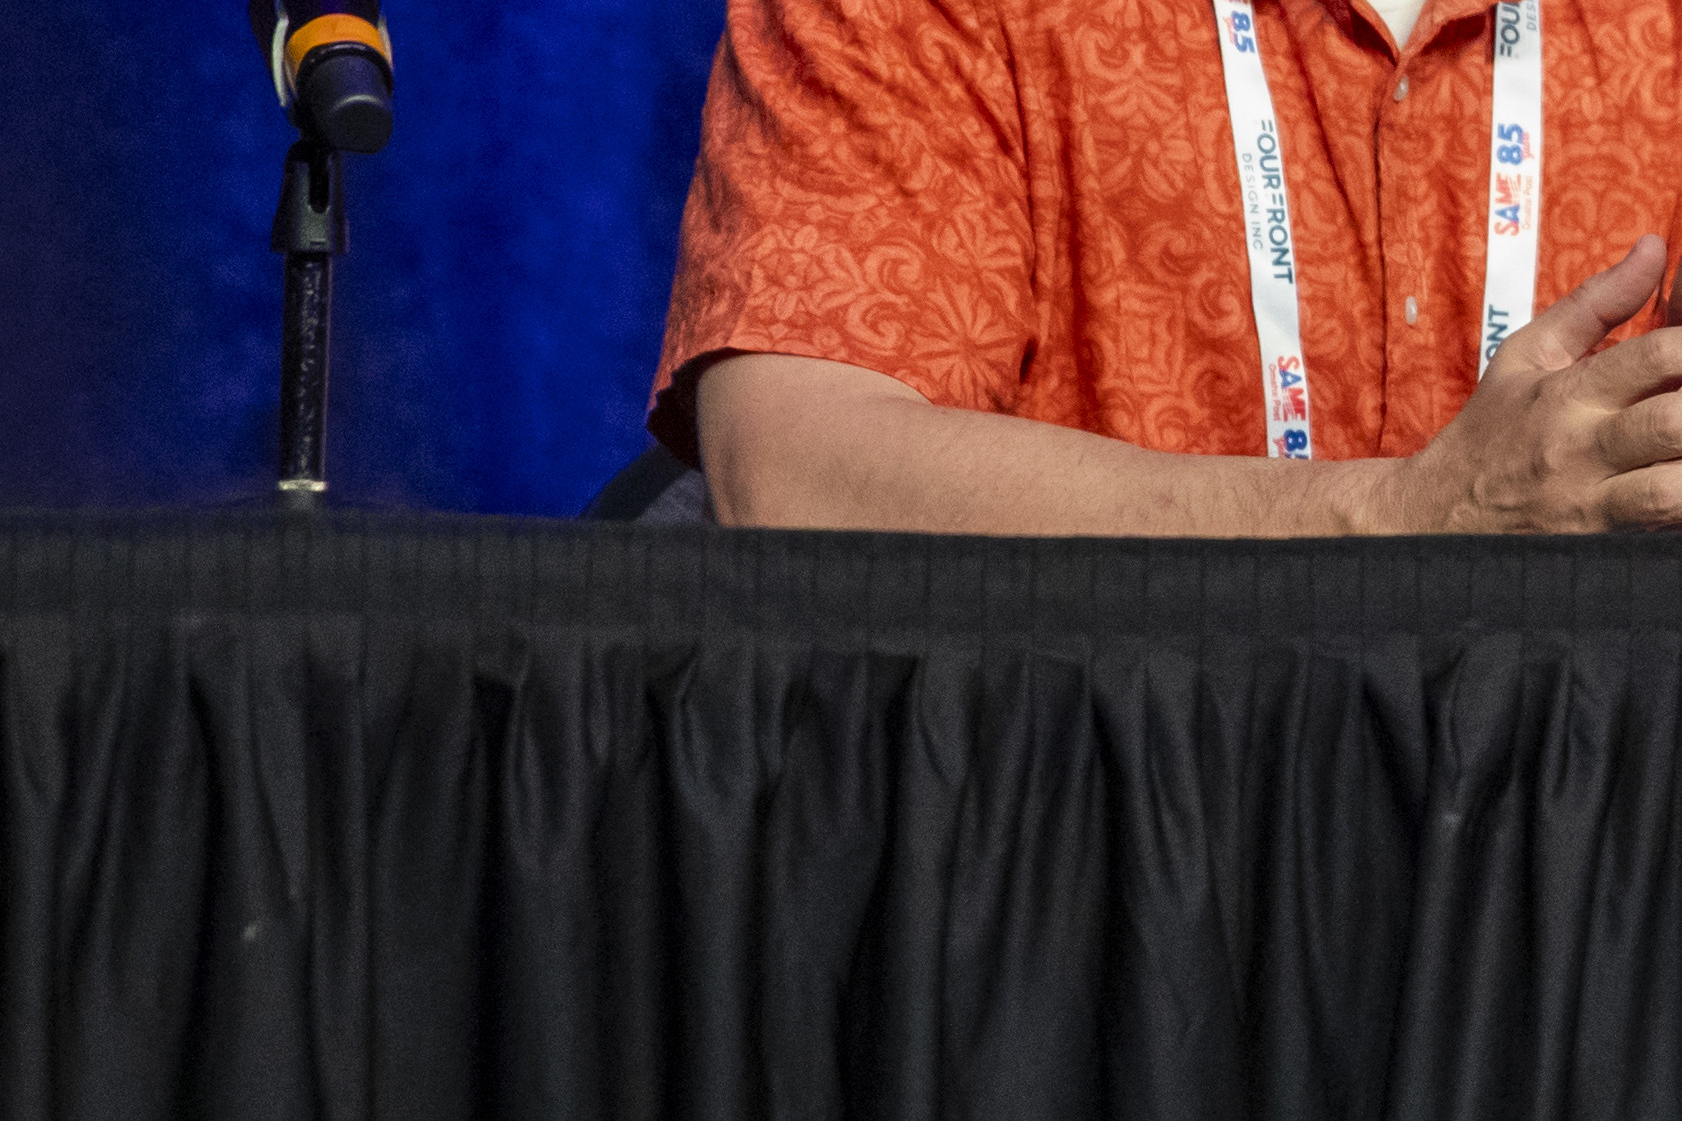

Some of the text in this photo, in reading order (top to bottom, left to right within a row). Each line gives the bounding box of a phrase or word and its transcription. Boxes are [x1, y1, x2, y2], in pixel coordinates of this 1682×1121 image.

[1231, 10, 1255, 53] 85
[1242, 153, 1263, 250] DESIGN INC
[1494, 123, 1523, 236] SAME 85
[1278, 356, 1306, 422] SAME
[1284, 429, 1309, 459] 8
